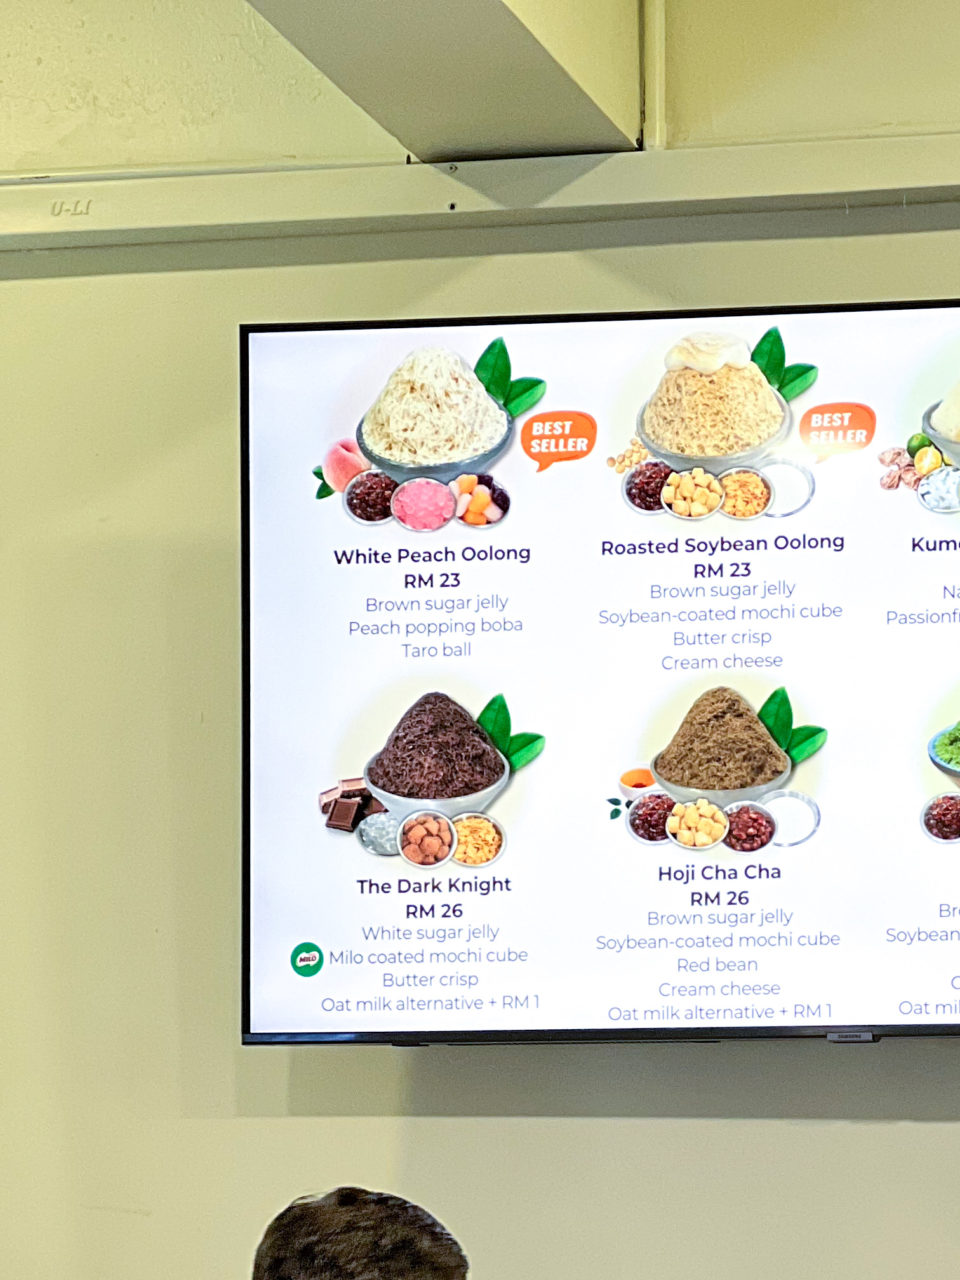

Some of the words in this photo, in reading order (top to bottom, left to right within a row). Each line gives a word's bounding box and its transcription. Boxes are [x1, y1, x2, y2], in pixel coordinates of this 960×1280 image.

[811, 411, 852, 428] BEST
[532, 420, 574, 437] BEST
[530, 437, 589, 454] SELLER
[602, 538, 678, 556] Roasted
[685, 536, 768, 556] Soybean
[774, 533, 844, 552] Oolong
[333, 547, 392, 565] White
[398, 546, 455, 563] Peach
[461, 545, 530, 564] Oolong
[694, 563, 723, 578] RM
[730, 562, 751, 577] 23
[404, 573, 434, 589] RM
[439, 573, 460, 588] 23
[651, 585, 705, 599] Brown
[711, 585, 758, 599] sugar
[761, 580, 795, 599] jelly
[366, 598, 420, 612] Brown
[425, 599, 474, 615] sugar
[475, 594, 508, 613] jelly
[599, 606, 736, 627] Soybean-coated
[742, 604, 795, 619] mochi
[800, 603, 843, 618] cube
[349, 620, 400, 635] Peach
[406, 618, 475, 637] popping
[481, 617, 522, 632] boba
[674, 632, 726, 646] Butter
[731, 629, 772, 646] crisp
[401, 644, 438, 657] Taro
[443, 642, 471, 656] ball
[662, 656, 717, 670] Cream
[723, 654, 783, 668] cheese
[659, 864, 695, 885] Hoji
[701, 864, 738, 880] Cha
[744, 864, 781, 879] Cha
[356, 879, 392, 894] The
[398, 877, 443, 893] Dark
[448, 876, 512, 896] Knight
[691, 891, 720, 906] RM
[726, 891, 749, 905] 26
[406, 904, 435, 919] RM
[441, 903, 463, 918] 26
[362, 926, 412, 940] White
[417, 928, 463, 943] sugar
[466, 924, 499, 942] jelly
[330, 950, 363, 965] Milo
[367, 949, 426, 964] coated
[430, 948, 481, 963] mochi
[486, 948, 528, 962] cube
[659, 983, 715, 996] Cream
[721, 981, 780, 995] cheese
[608, 1007, 638, 1020] Oat
[644, 1006, 680, 1020] milk
[685, 1005, 774, 1019] alternative
[794, 1004, 821, 1017] RM
